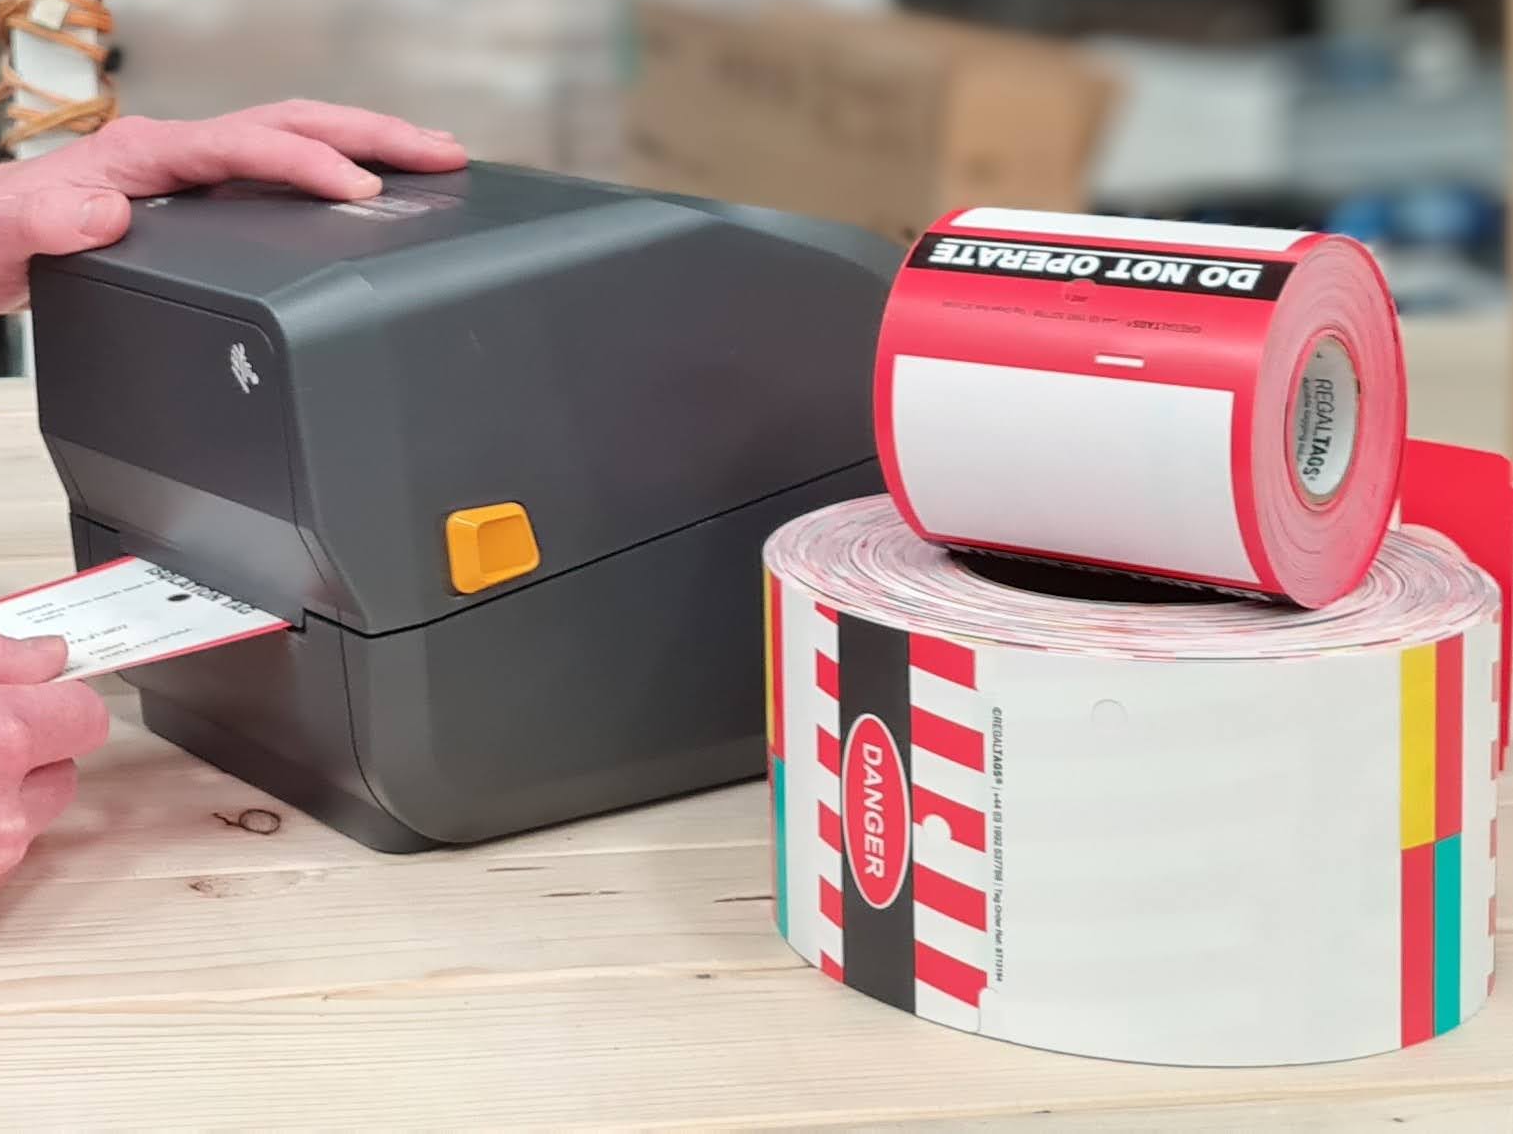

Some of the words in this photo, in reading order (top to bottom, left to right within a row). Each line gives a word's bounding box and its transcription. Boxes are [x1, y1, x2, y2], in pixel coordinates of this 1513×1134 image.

[928, 242, 1100, 276] OPERATE
[1105, 257, 1192, 285] NOT
[1197, 265, 1263, 291] DO
[862, 742, 886, 879] DANGER
